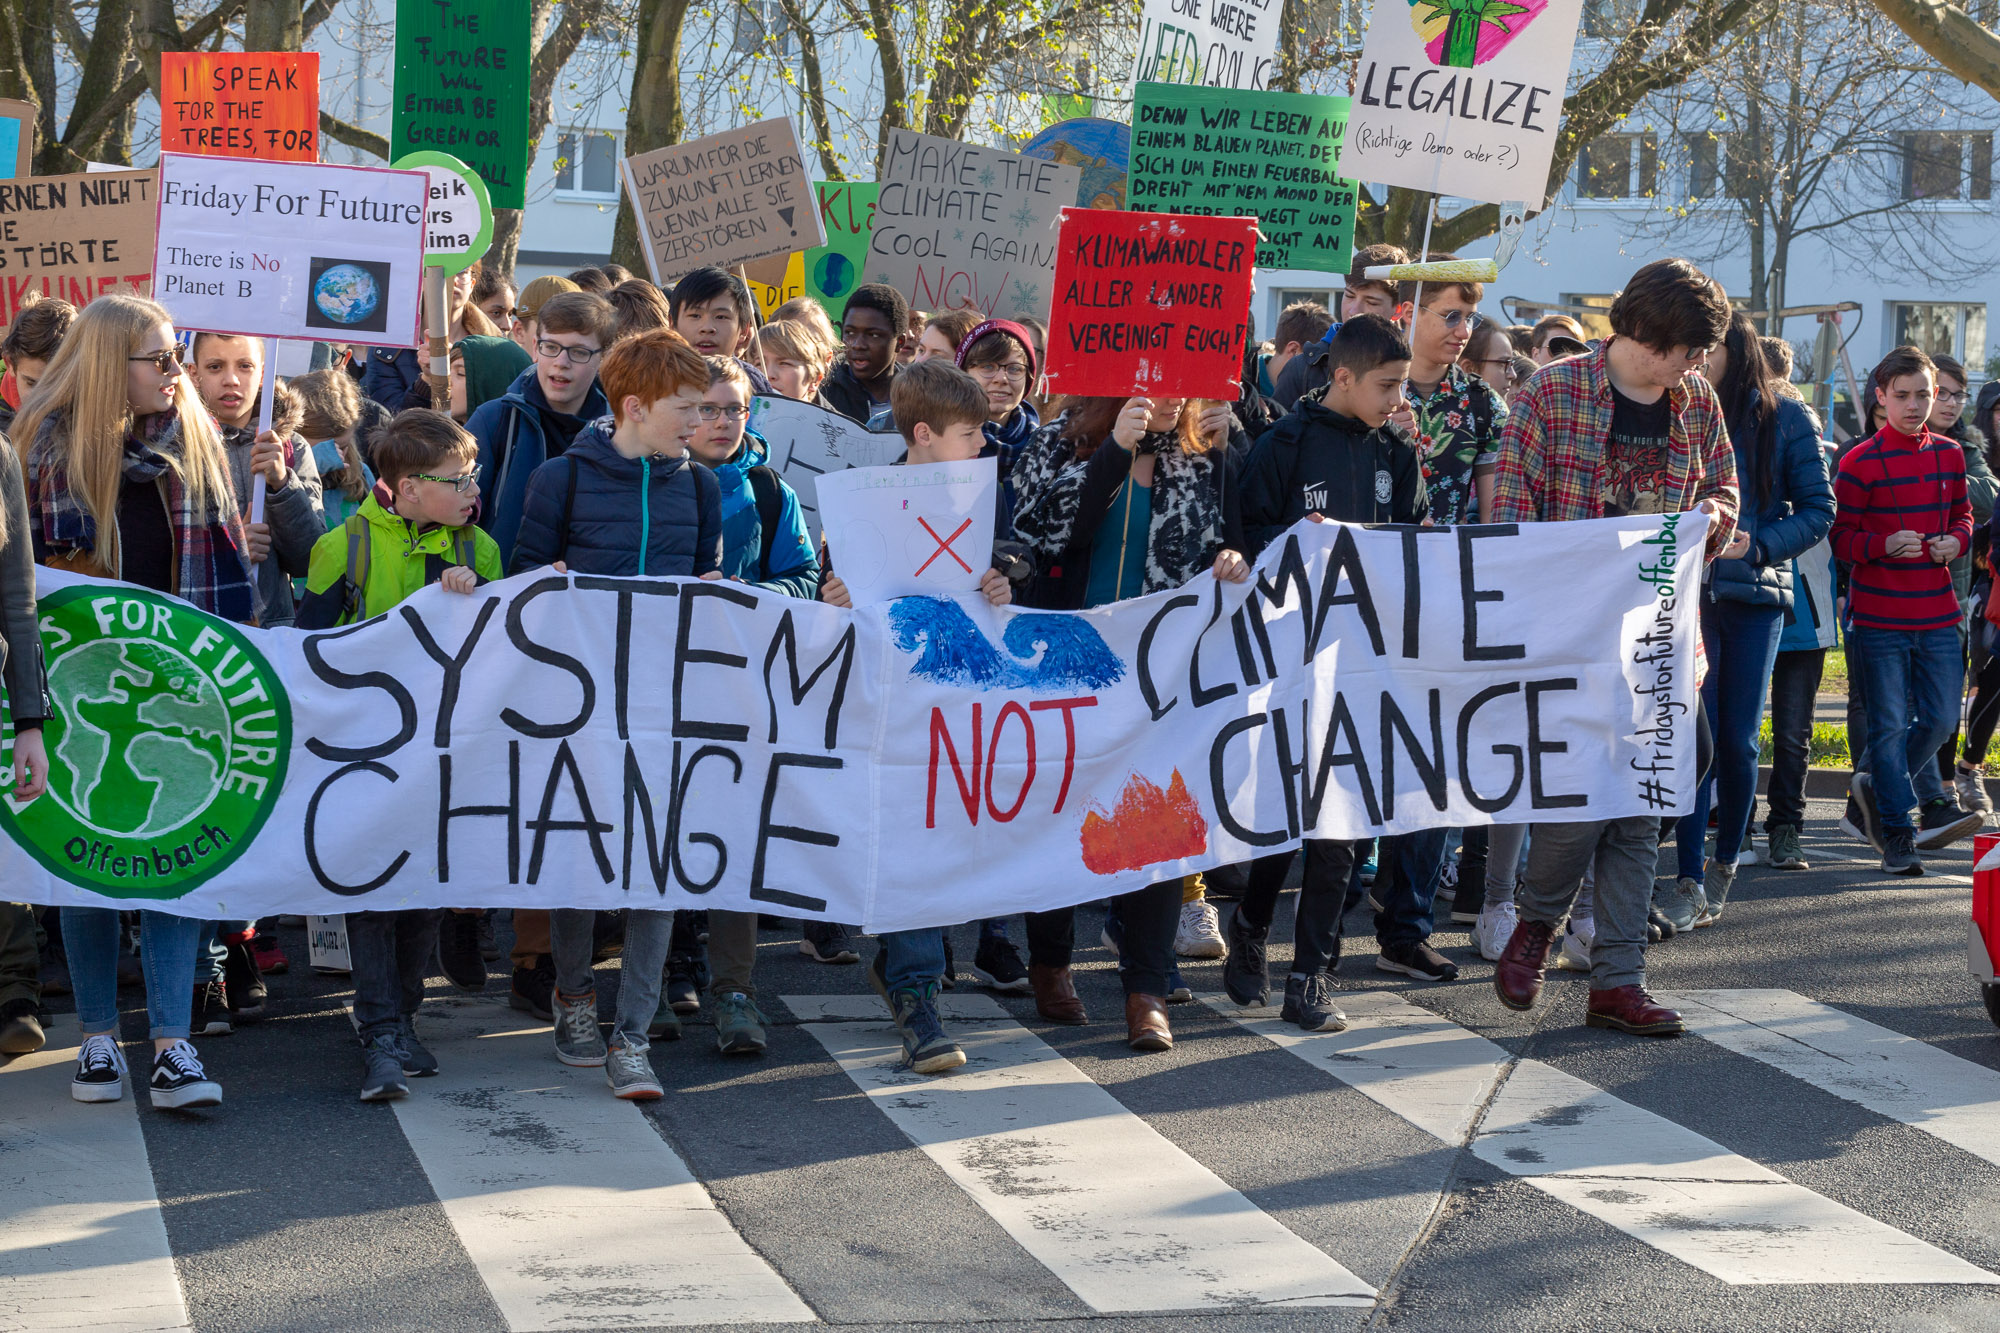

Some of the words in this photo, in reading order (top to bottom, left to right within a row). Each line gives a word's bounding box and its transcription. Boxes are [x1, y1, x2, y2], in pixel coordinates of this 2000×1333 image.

[432, 0, 479, 34] THE
[1211, 0, 1257, 42] WHERE
[414, 36, 507, 70] FUTURE
[183, 67, 187, 91] I
[212, 67, 298, 91] SPEAK
[440, 72, 483, 91] WILL
[173, 101, 215, 121] FOR
[223, 101, 264, 119] THE
[405, 93, 465, 115] EITHER
[472, 96, 497, 119] BE
[1360, 61, 1551, 133] LEGALIZE
[407, 121, 470, 145] GREEN
[475, 130, 501, 147] OR
[1140, 105, 1188, 126] DENN
[1200, 107, 1240, 130] WIR
[1250, 110, 1312, 136] LEBEN
[1317, 118, 1348, 139] AU
[180, 127, 258, 154] TREES,
[264, 129, 313, 151] FOR
[1136, 130, 1186, 149] EINEM
[1193, 133, 1252, 154] BLAUEN
[1422, 132, 1454, 156] Demo
[632, 153, 706, 188] WARUM
[707, 143, 742, 168] FÜR
[745, 135, 771, 159] DIE
[887, 134, 980, 186] MAKE
[998, 159, 1059, 194] THE
[1133, 153, 1174, 175] SICH
[1181, 158, 1204, 176] UM
[1212, 160, 1258, 179] EINEN
[1264, 164, 1349, 188] FEUERBALL
[80, 178, 151, 207] NICHT
[643, 171, 734, 213] ZUKUNFT
[739, 154, 804, 187] LERNEN
[1133, 179, 1192, 198] DREHT
[1273, 185, 1318, 202] MOND
[1324, 189, 1353, 206] DER
[164, 181, 248, 216] Friday
[252, 184, 309, 216] For
[316, 189, 421, 225] Future
[649, 206, 709, 239] WENN
[715, 192, 758, 220] ALLE
[765, 181, 794, 205] SIE
[879, 183, 1003, 222] CLIMATE
[1308, 212, 1342, 226] UND
[657, 216, 767, 263] ZERSTÖREN
[872, 226, 947, 258] COOL
[1076, 233, 1245, 273] KLIMAWANDLER
[1312, 233, 1340, 251] AN
[167, 247, 223, 268] There
[228, 251, 244, 269] is
[251, 253, 280, 272] No
[164, 275, 225, 296] Planet
[237, 280, 252, 298] B
[910, 264, 1009, 317] NOW
[1064, 279, 1134, 308] ALLER
[1150, 279, 1224, 310] LÄNDER
[1068, 322, 1175, 353] VEREINIGT
[1184, 323, 1246, 361] EUCH!
[1304, 490, 1328, 510] BW
[1136, 523, 1526, 721] CLIMATE
[303, 576, 855, 762] SYSTEM
[91, 597, 178, 640] FOR
[189, 626, 279, 800] FUTURE
[926, 696, 1098, 829] NOT
[1209, 678, 1588, 847] CHANGE
[303, 739, 844, 912] CHANGE
